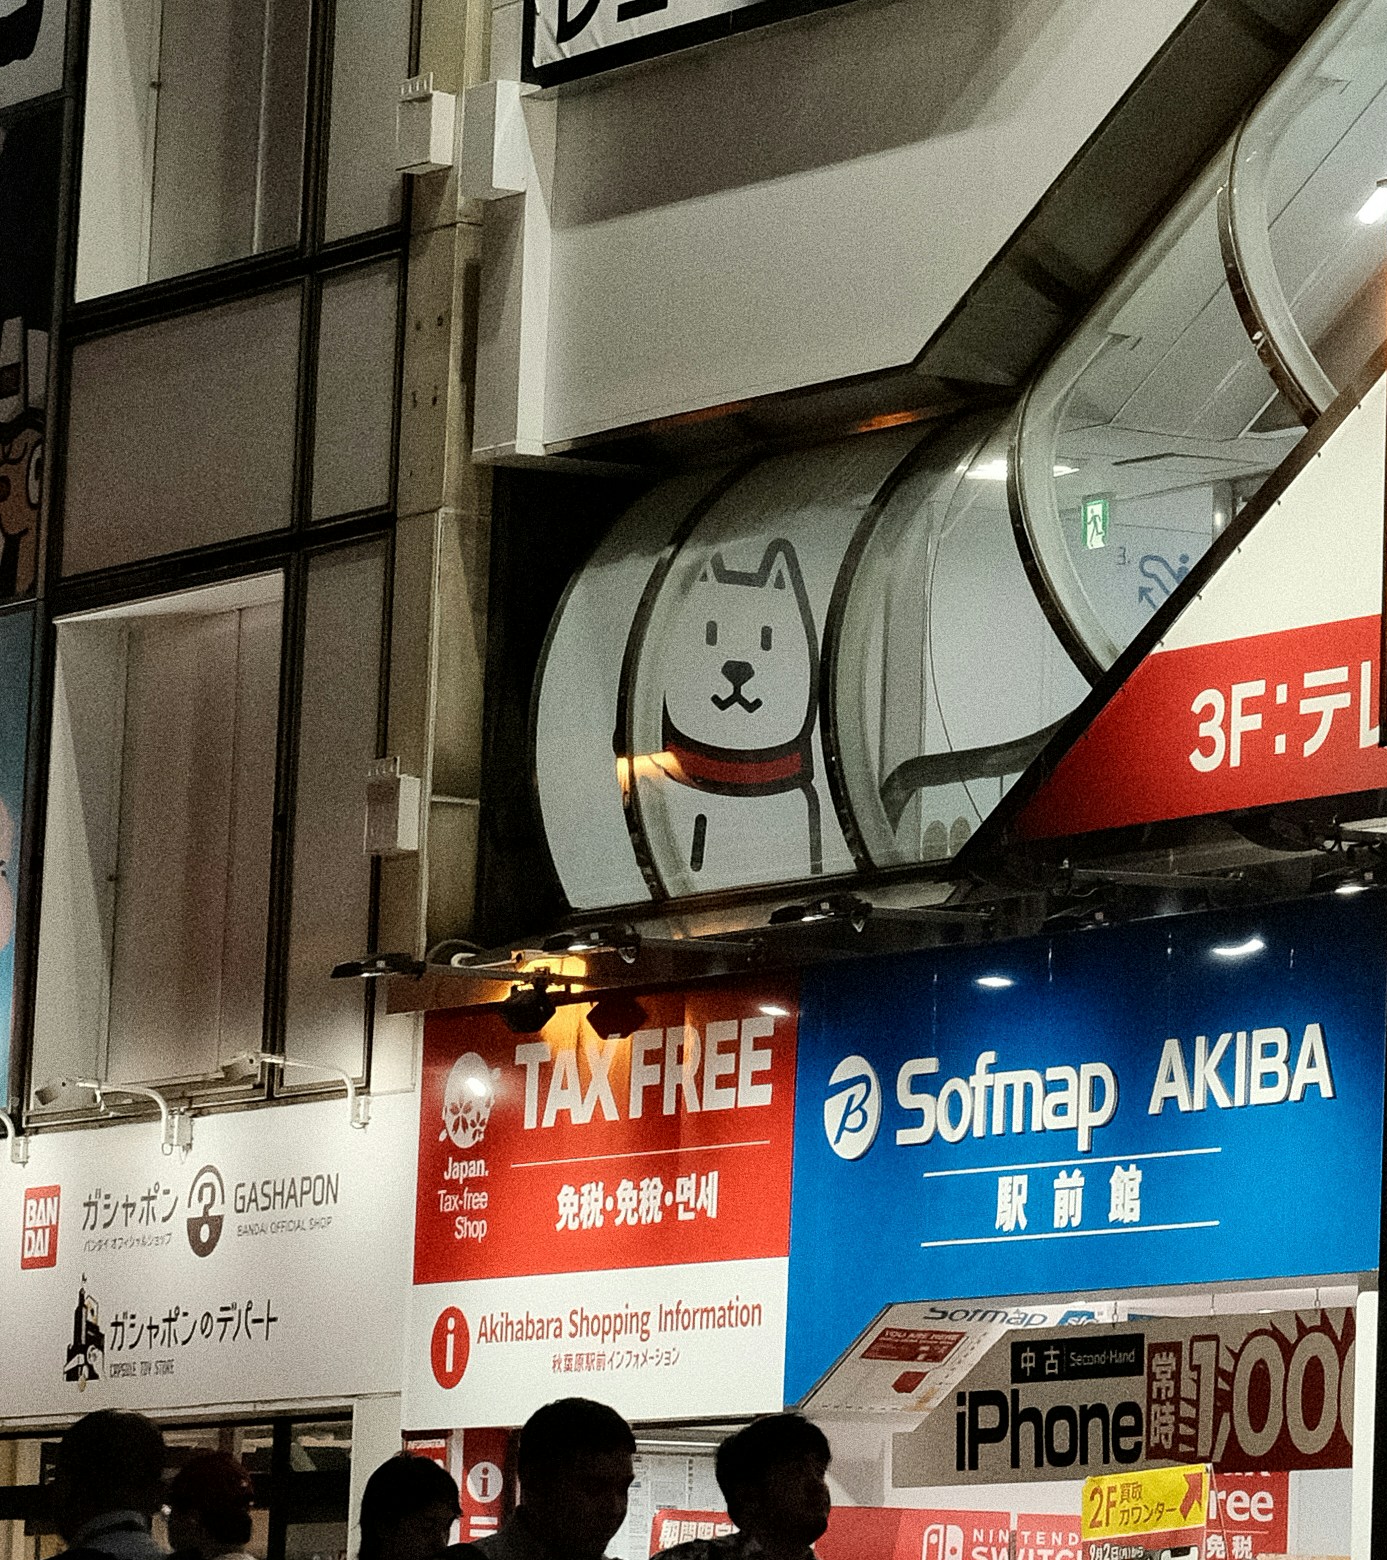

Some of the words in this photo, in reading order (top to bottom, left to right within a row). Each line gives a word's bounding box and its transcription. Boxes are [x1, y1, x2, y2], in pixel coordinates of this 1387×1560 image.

[514, 1033, 620, 1130] TAX
[628, 1016, 776, 1120] FREE
[896, 1049, 1119, 1153] Sofmap
[1148, 1022, 1336, 1116] AKIBA
[443, 1157, 489, 1183] Japan.
[25, 1196, 58, 1227] BAN
[82, 1180, 179, 1231] ガシャポン
[234, 1172, 340, 1214] GASHAPON
[995, 1164, 1143, 1232] 駅前館
[23, 1228, 50, 1258] DAI
[269, 1220, 306, 1234] OFFICIAL
[309, 1216, 333, 1231] SHOP
[454, 1215, 488, 1243] Shop
[110, 1298, 279, 1352] ガシャポンのデパート
[476, 1308, 563, 1345] Akihabara
[567, 1301, 651, 1343] Shopping
[657, 1294, 763, 1332] Information
[551, 1346, 681, 1374] 秋葉原駅前インフォメーション
[1020, 1345, 1060, 1377] 中古
[1151, 1350, 1177, 1451] 常時
[956, 1388, 1144, 1473] iPhone
[1089, 1486, 1118, 1528] 2F
[1118, 1503, 1179, 1527] カウンター
[1206, 1531, 1254, 1560] 免税
